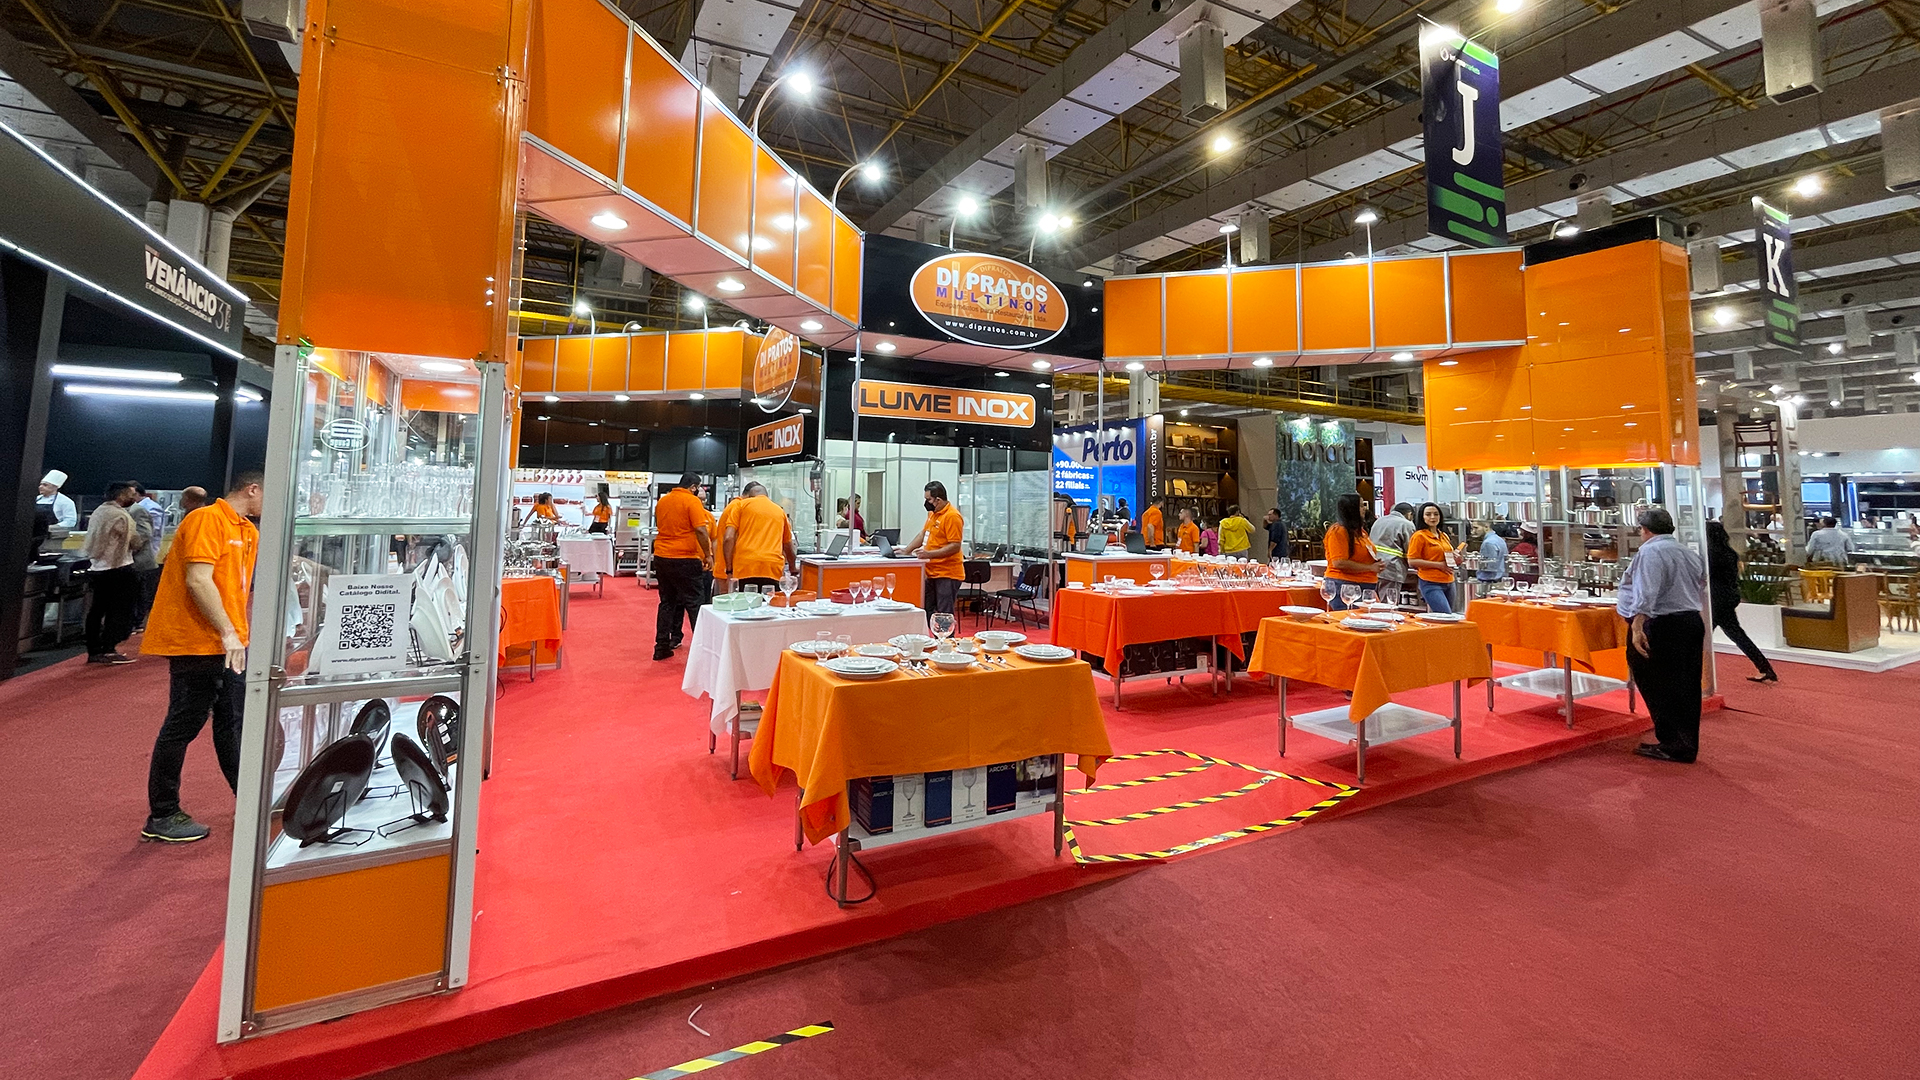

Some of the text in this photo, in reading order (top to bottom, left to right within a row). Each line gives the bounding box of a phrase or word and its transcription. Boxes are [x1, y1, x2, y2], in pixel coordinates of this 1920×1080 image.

[1452, 80, 1478, 166] J
[1763, 233, 1789, 297] K
[145, 250, 217, 316] VENÂNCIO
[936, 266, 960, 289] DI
[966, 271, 1048, 303] PRATOS
[936, 286, 1047, 314] MULTINOX
[945, 320, 1039, 338] www.dipratos.com.br
[768, 333, 794, 364] PRATOS
[860, 388, 1030, 421] LUME INOX
[748, 423, 801, 454] LUME INOX
[1055, 470, 1061, 479] 2
[1055, 480, 1064, 489] 22
[989, 763, 1016, 773] ARCORC
